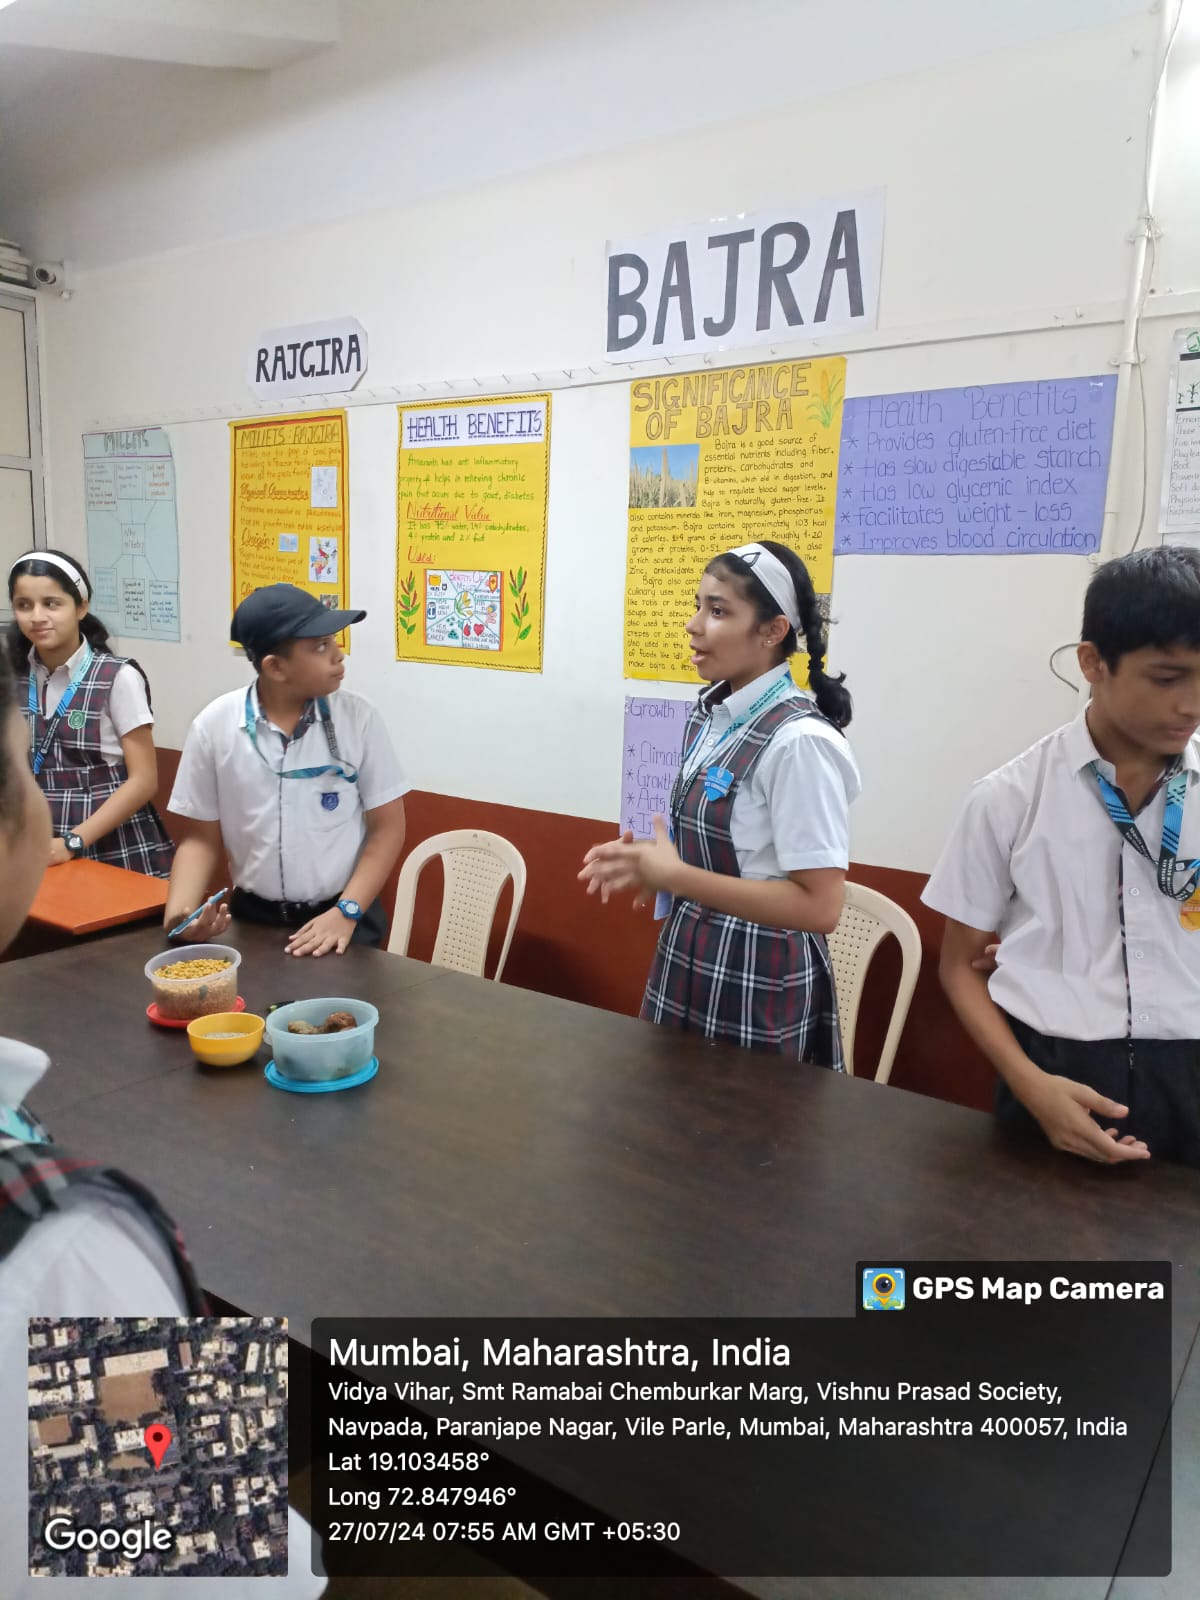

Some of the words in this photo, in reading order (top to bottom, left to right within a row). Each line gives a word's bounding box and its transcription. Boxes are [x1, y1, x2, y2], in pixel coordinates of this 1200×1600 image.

[607, 209, 864, 353] BAJRA
[256, 334, 361, 382] RAJGIRA
[633, 363, 811, 412] SIGNIFICANCE
[867, 392, 943, 429] Health
[963, 381, 1078, 422] Benefits
[407, 414, 458, 439] HEALTH
[467, 410, 543, 436] BENEFITS
[646, 409, 682, 440] OF
[696, 398, 793, 438] BAJRA
[715, 438, 736, 451] Bajra
[740, 438, 746, 448] is
[757, 437, 774, 450] good
[779, 437, 803, 445] source
[809, 433, 817, 443] of
[867, 431, 935, 453] Provides
[948, 420, 1049, 455] gluten-free
[1057, 418, 1097, 442] diet
[704, 452, 736, 462] essential
[740, 450, 771, 460] nutrients
[775, 447, 807, 459] including
[800, 460, 814, 468] and
[862, 459, 896, 479] Has
[903, 456, 937, 476] slow
[943, 450, 1026, 479] digestable
[1037, 446, 1101, 470] starch
[464, 474, 493, 490] relieving
[498, 472, 526, 482] chronic
[820, 470, 833, 479] and
[759, 484, 778, 493] blood
[782, 485, 800, 494] sugar
[860, 481, 896, 502] Has
[907, 480, 935, 500] low
[947, 477, 1012, 504] glycemic
[1026, 471, 1078, 495] index
[701, 499, 720, 509] Bajra
[725, 498, 731, 506] is
[735, 496, 766, 507] naturally
[815, 494, 825, 503] It
[406, 501, 459, 520] Nutritional
[629, 513, 645, 521] also
[647, 512, 674, 520] contains
[779, 508, 824, 518] phosphorus
[853, 505, 944, 527] Facilitates
[958, 502, 1012, 530] weight
[1035, 501, 1072, 522] loss
[683, 521, 703, 532] Bajra
[707, 522, 736, 530] contains
[741, 519, 790, 530] approximately
[812, 519, 827, 527] kcal
[630, 534, 638, 543] of
[687, 535, 706, 543] grams
[709, 533, 717, 541] of
[771, 531, 800, 540] Roughly
[858, 532, 938, 555] Improves
[946, 527, 995, 549] blood
[1007, 526, 1097, 549] circulation
[632, 546, 654, 556] grams
[657, 544, 665, 553] of
[795, 542, 801, 550] is
[807, 542, 823, 551] also
[678, 556, 685, 564] of
[653, 566, 694, 575] antioxidants
[642, 573, 663, 588] Bajra
[668, 577, 681, 585] also
[680, 587, 696, 596] such
[628, 610, 646, 618] soups
[627, 630, 650, 638] crepes
[628, 648, 636, 657] of
[639, 648, 657, 658] foods
[649, 661, 666, 672] bajra
[630, 697, 675, 719] Growth
